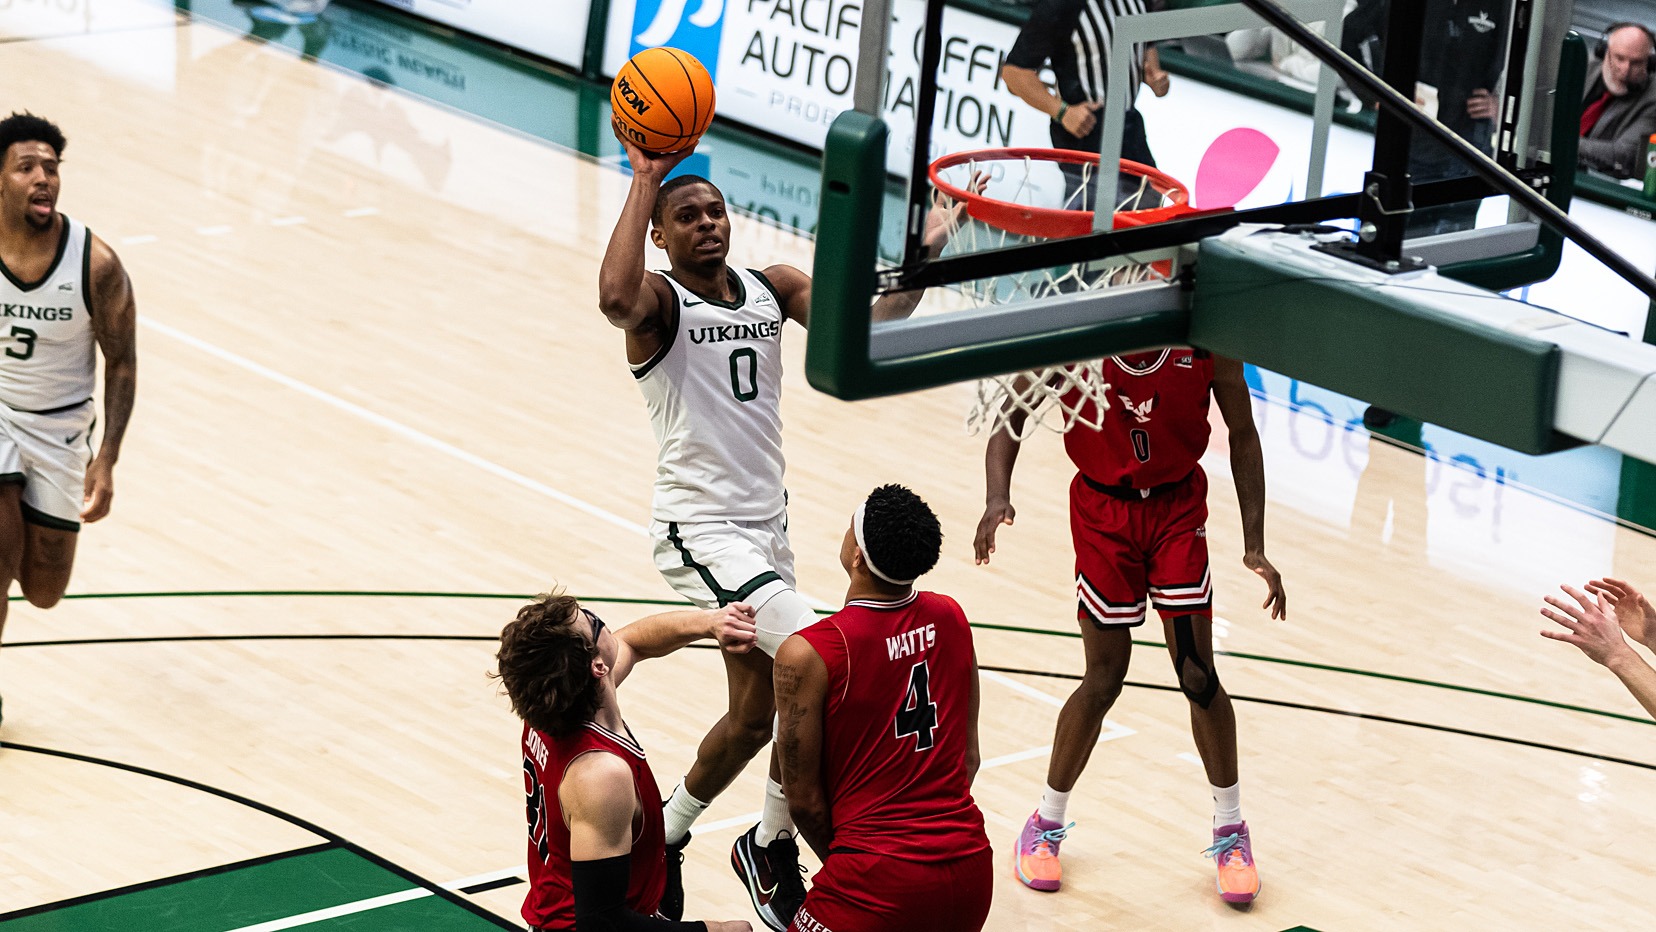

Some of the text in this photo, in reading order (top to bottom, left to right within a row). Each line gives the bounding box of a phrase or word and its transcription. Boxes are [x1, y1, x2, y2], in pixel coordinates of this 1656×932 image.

[913, 25, 1005, 91] FFI
[618, 75, 651, 116] NCAA
[741, 30, 1014, 148] AUTOAION
[0, 303, 73, 321] KINGS
[688, 320, 779, 344] VIKINGS
[5, 325, 38, 361] 3
[729, 347, 758, 402] 0
[1130, 428, 1151, 464] 0
[886, 623, 936, 661] WATTS
[894, 659, 939, 752] 4
[525, 727, 549, 772] JONES
